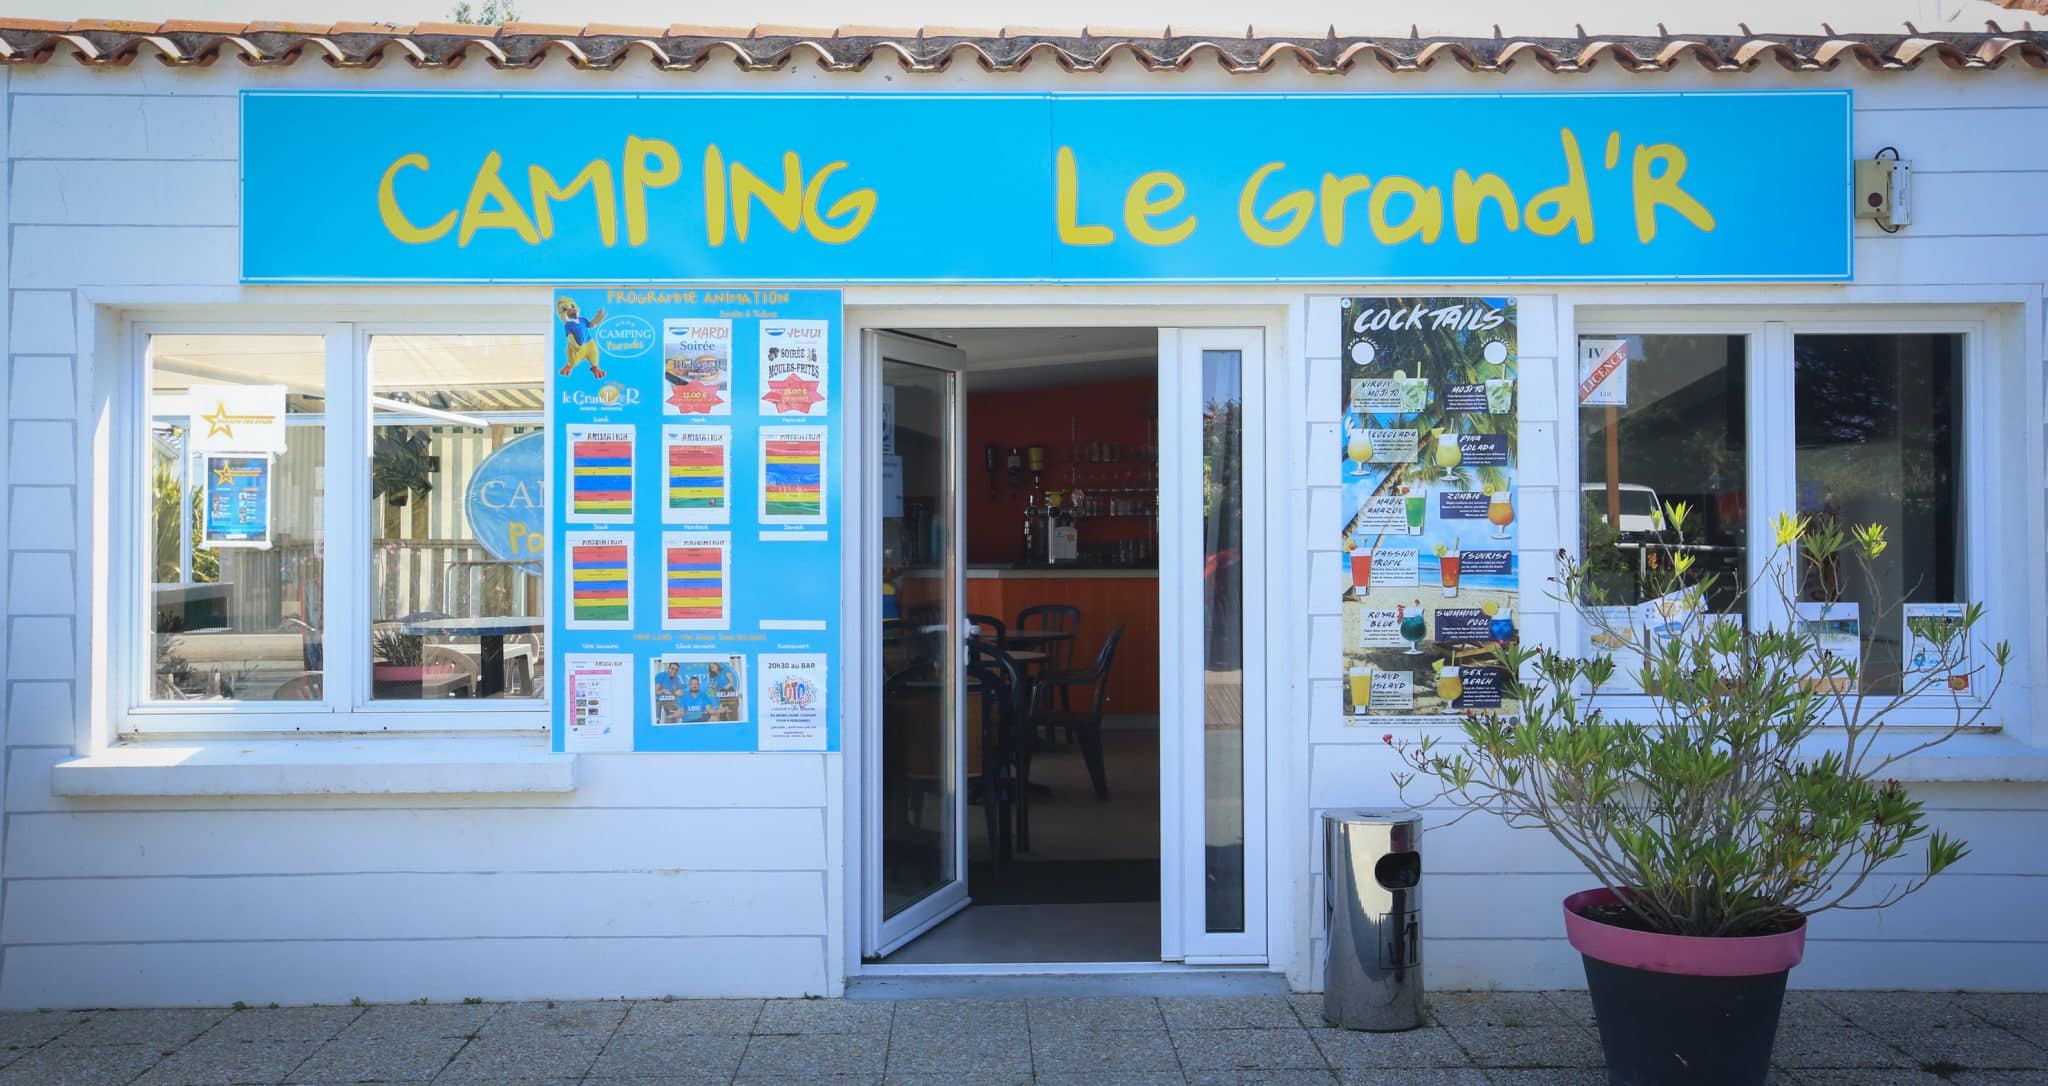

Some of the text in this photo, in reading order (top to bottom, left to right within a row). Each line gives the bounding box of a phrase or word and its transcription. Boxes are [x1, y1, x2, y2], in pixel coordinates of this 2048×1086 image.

[378, 135, 877, 247] CAMPING
[1057, 128, 1715, 246] Le Grand'R
[607, 289, 791, 305] PROGRAMME ANIMATION
[1353, 304, 1505, 333] COCKTAILS
[598, 328, 652, 339] CAMPING
[690, 326, 729, 340] MARDI
[680, 340, 716, 351] Soirée
[780, 347, 806, 359] SOIRÉE
[1588, 347, 1604, 359] IV
[768, 363, 820, 379] MOULES-FRITES
[1582, 350, 1626, 393] LICENCE
[1451, 384, 1485, 394] MOJITO
[1461, 443, 1496, 452] COLADA
[1447, 492, 1482, 501] ZOMBIE
[1374, 550, 1417, 558] PASSION
[1367, 611, 1397, 619] ROYAL
[1370, 620, 1396, 628] BLUE
[1466, 618, 1489, 626] POOL
[767, 662, 790, 670] 20h30
[801, 662, 816, 670] BAR
[1373, 672, 1401, 680] SAND
[1462, 668, 1482, 677] SEX
[1372, 682, 1407, 690] ISLAND
[1462, 678, 1494, 686] BEACH
[780, 680, 806, 703] LOTO
